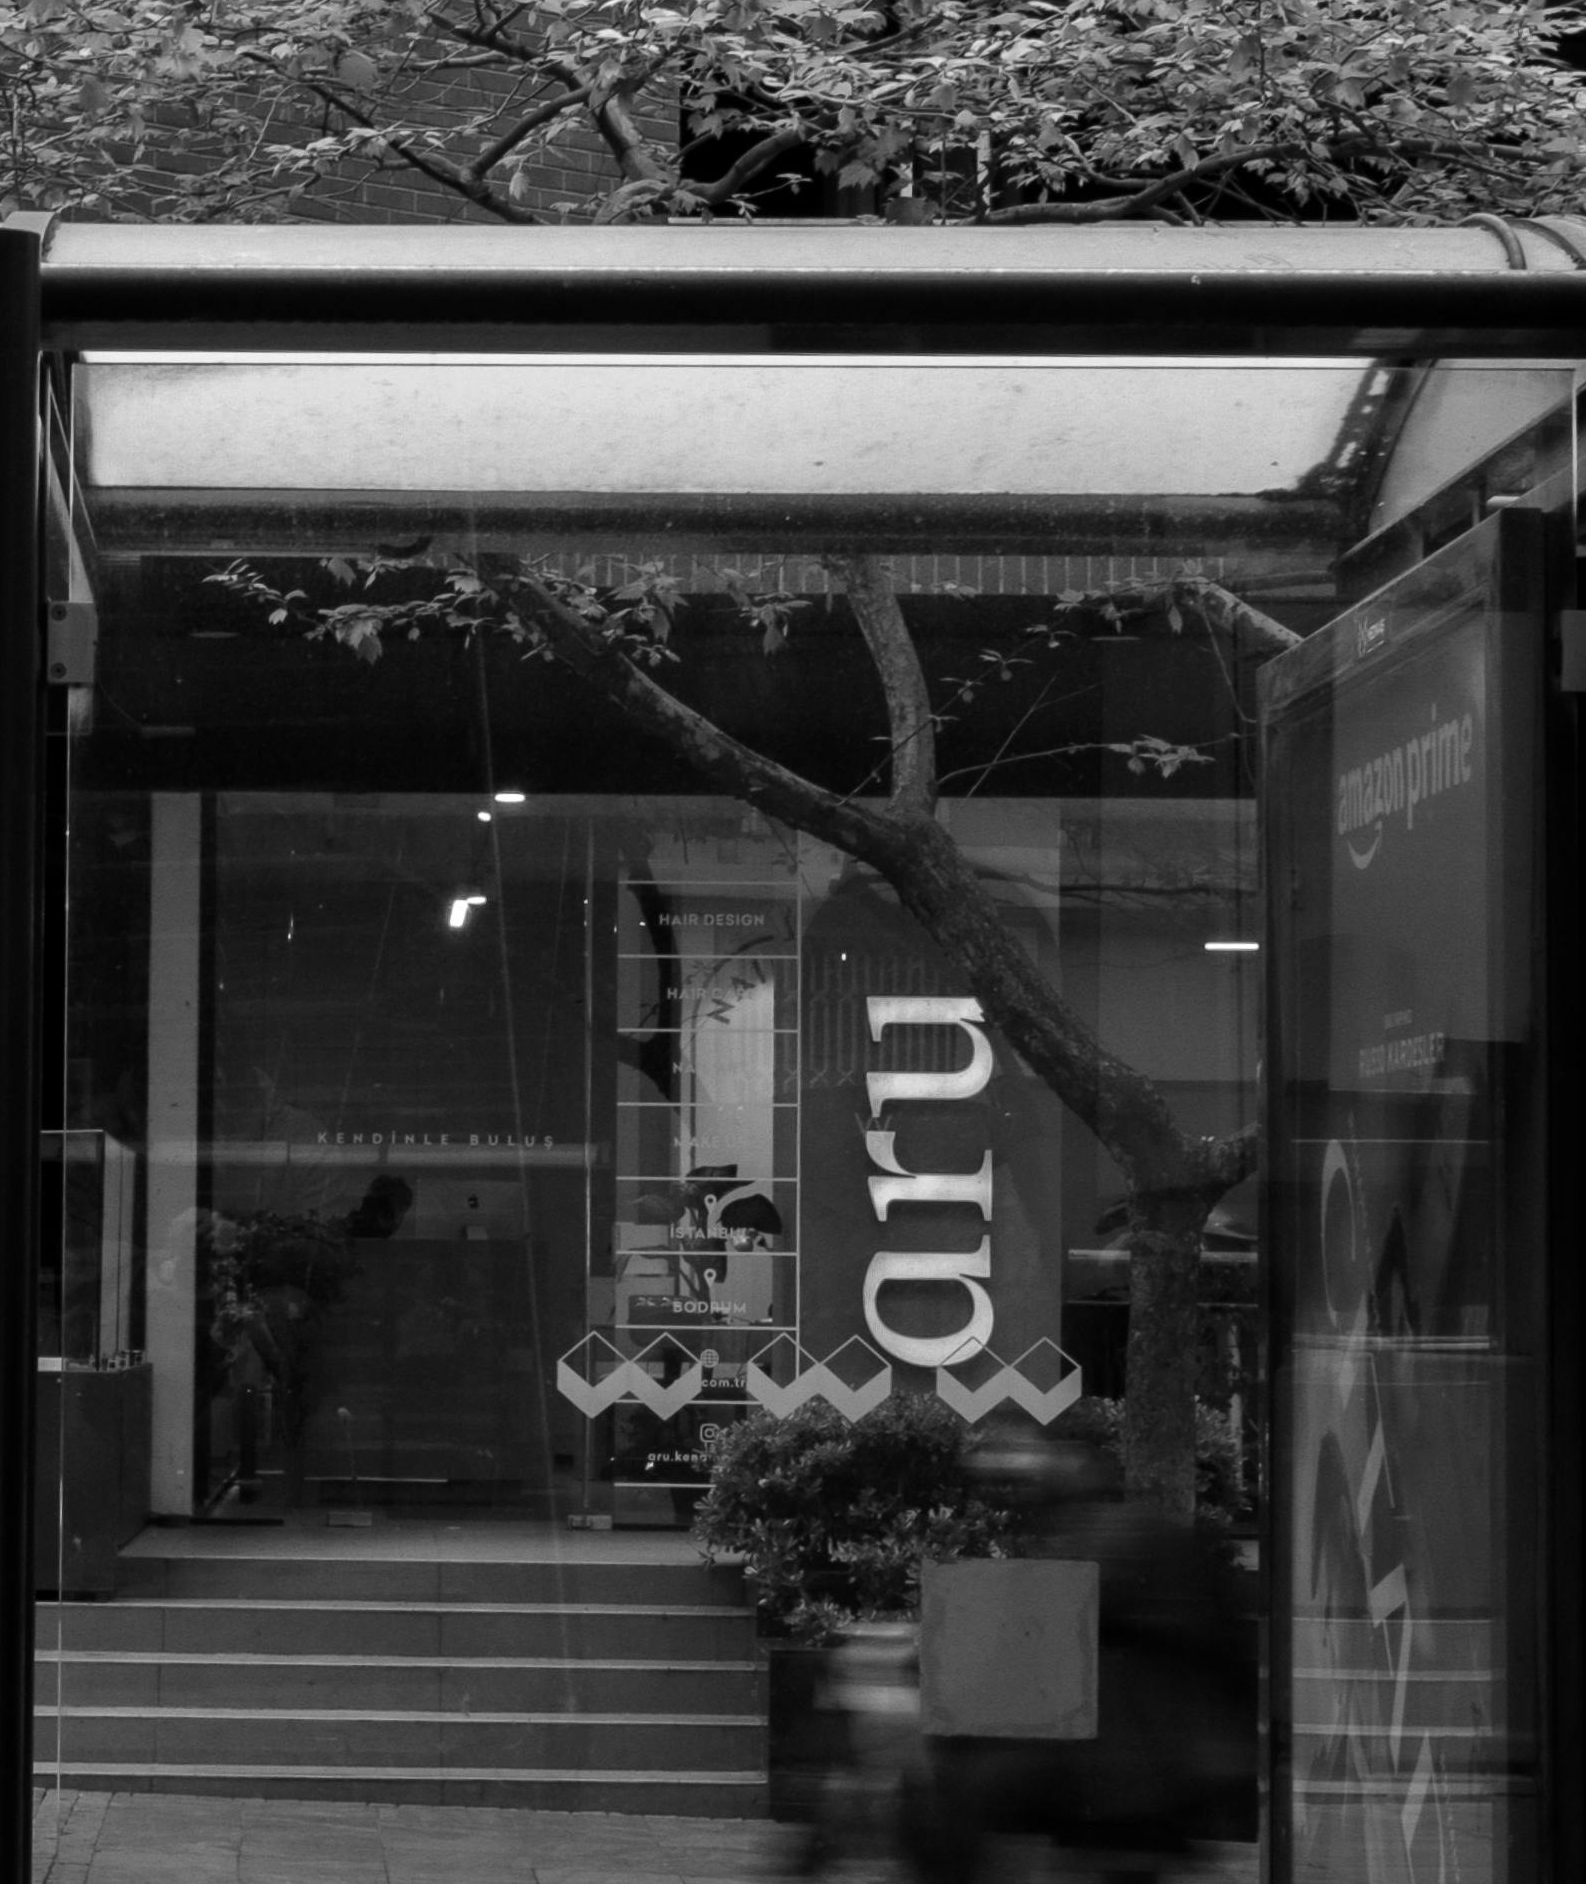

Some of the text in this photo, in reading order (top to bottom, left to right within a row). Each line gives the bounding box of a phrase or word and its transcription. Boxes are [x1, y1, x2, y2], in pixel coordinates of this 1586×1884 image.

[1338, 702, 1473, 835] amazon prime
[659, 913, 766, 927] HAIR DESIGN
[666, 987, 707, 1001] HAIR
[317, 1129, 555, 1150] KENDİNLE BULUŞ
[862, 995, 995, 1368] aru
[672, 1301, 747, 1314] BODRUM
